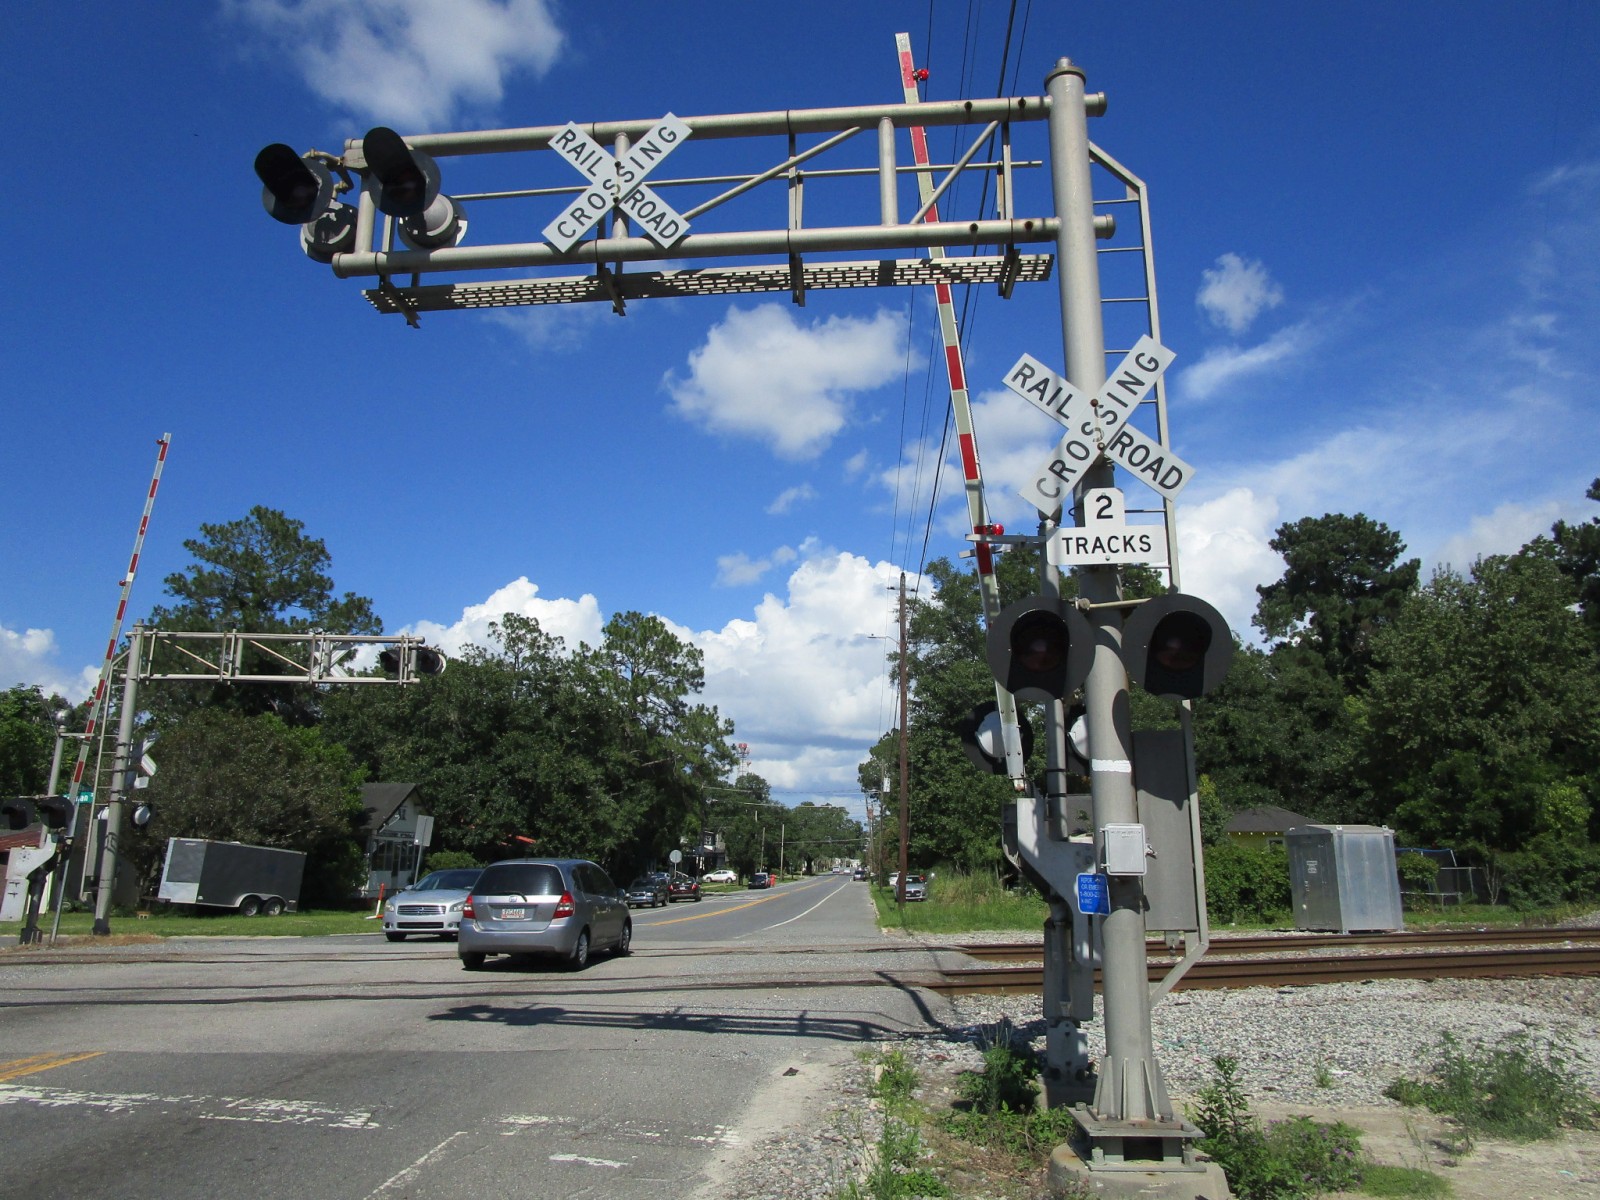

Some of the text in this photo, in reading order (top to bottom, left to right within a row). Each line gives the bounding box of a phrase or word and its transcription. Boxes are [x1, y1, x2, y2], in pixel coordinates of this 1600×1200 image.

[555, 129, 680, 239] RAIL ROAD
[557, 126, 677, 239] CROSSING
[1011, 362, 1183, 490] RAIL ROAD
[1036, 352, 1160, 499] CROSSING
[1061, 534, 1152, 555] TRACKS
[1095, 495, 1114, 520] 2
